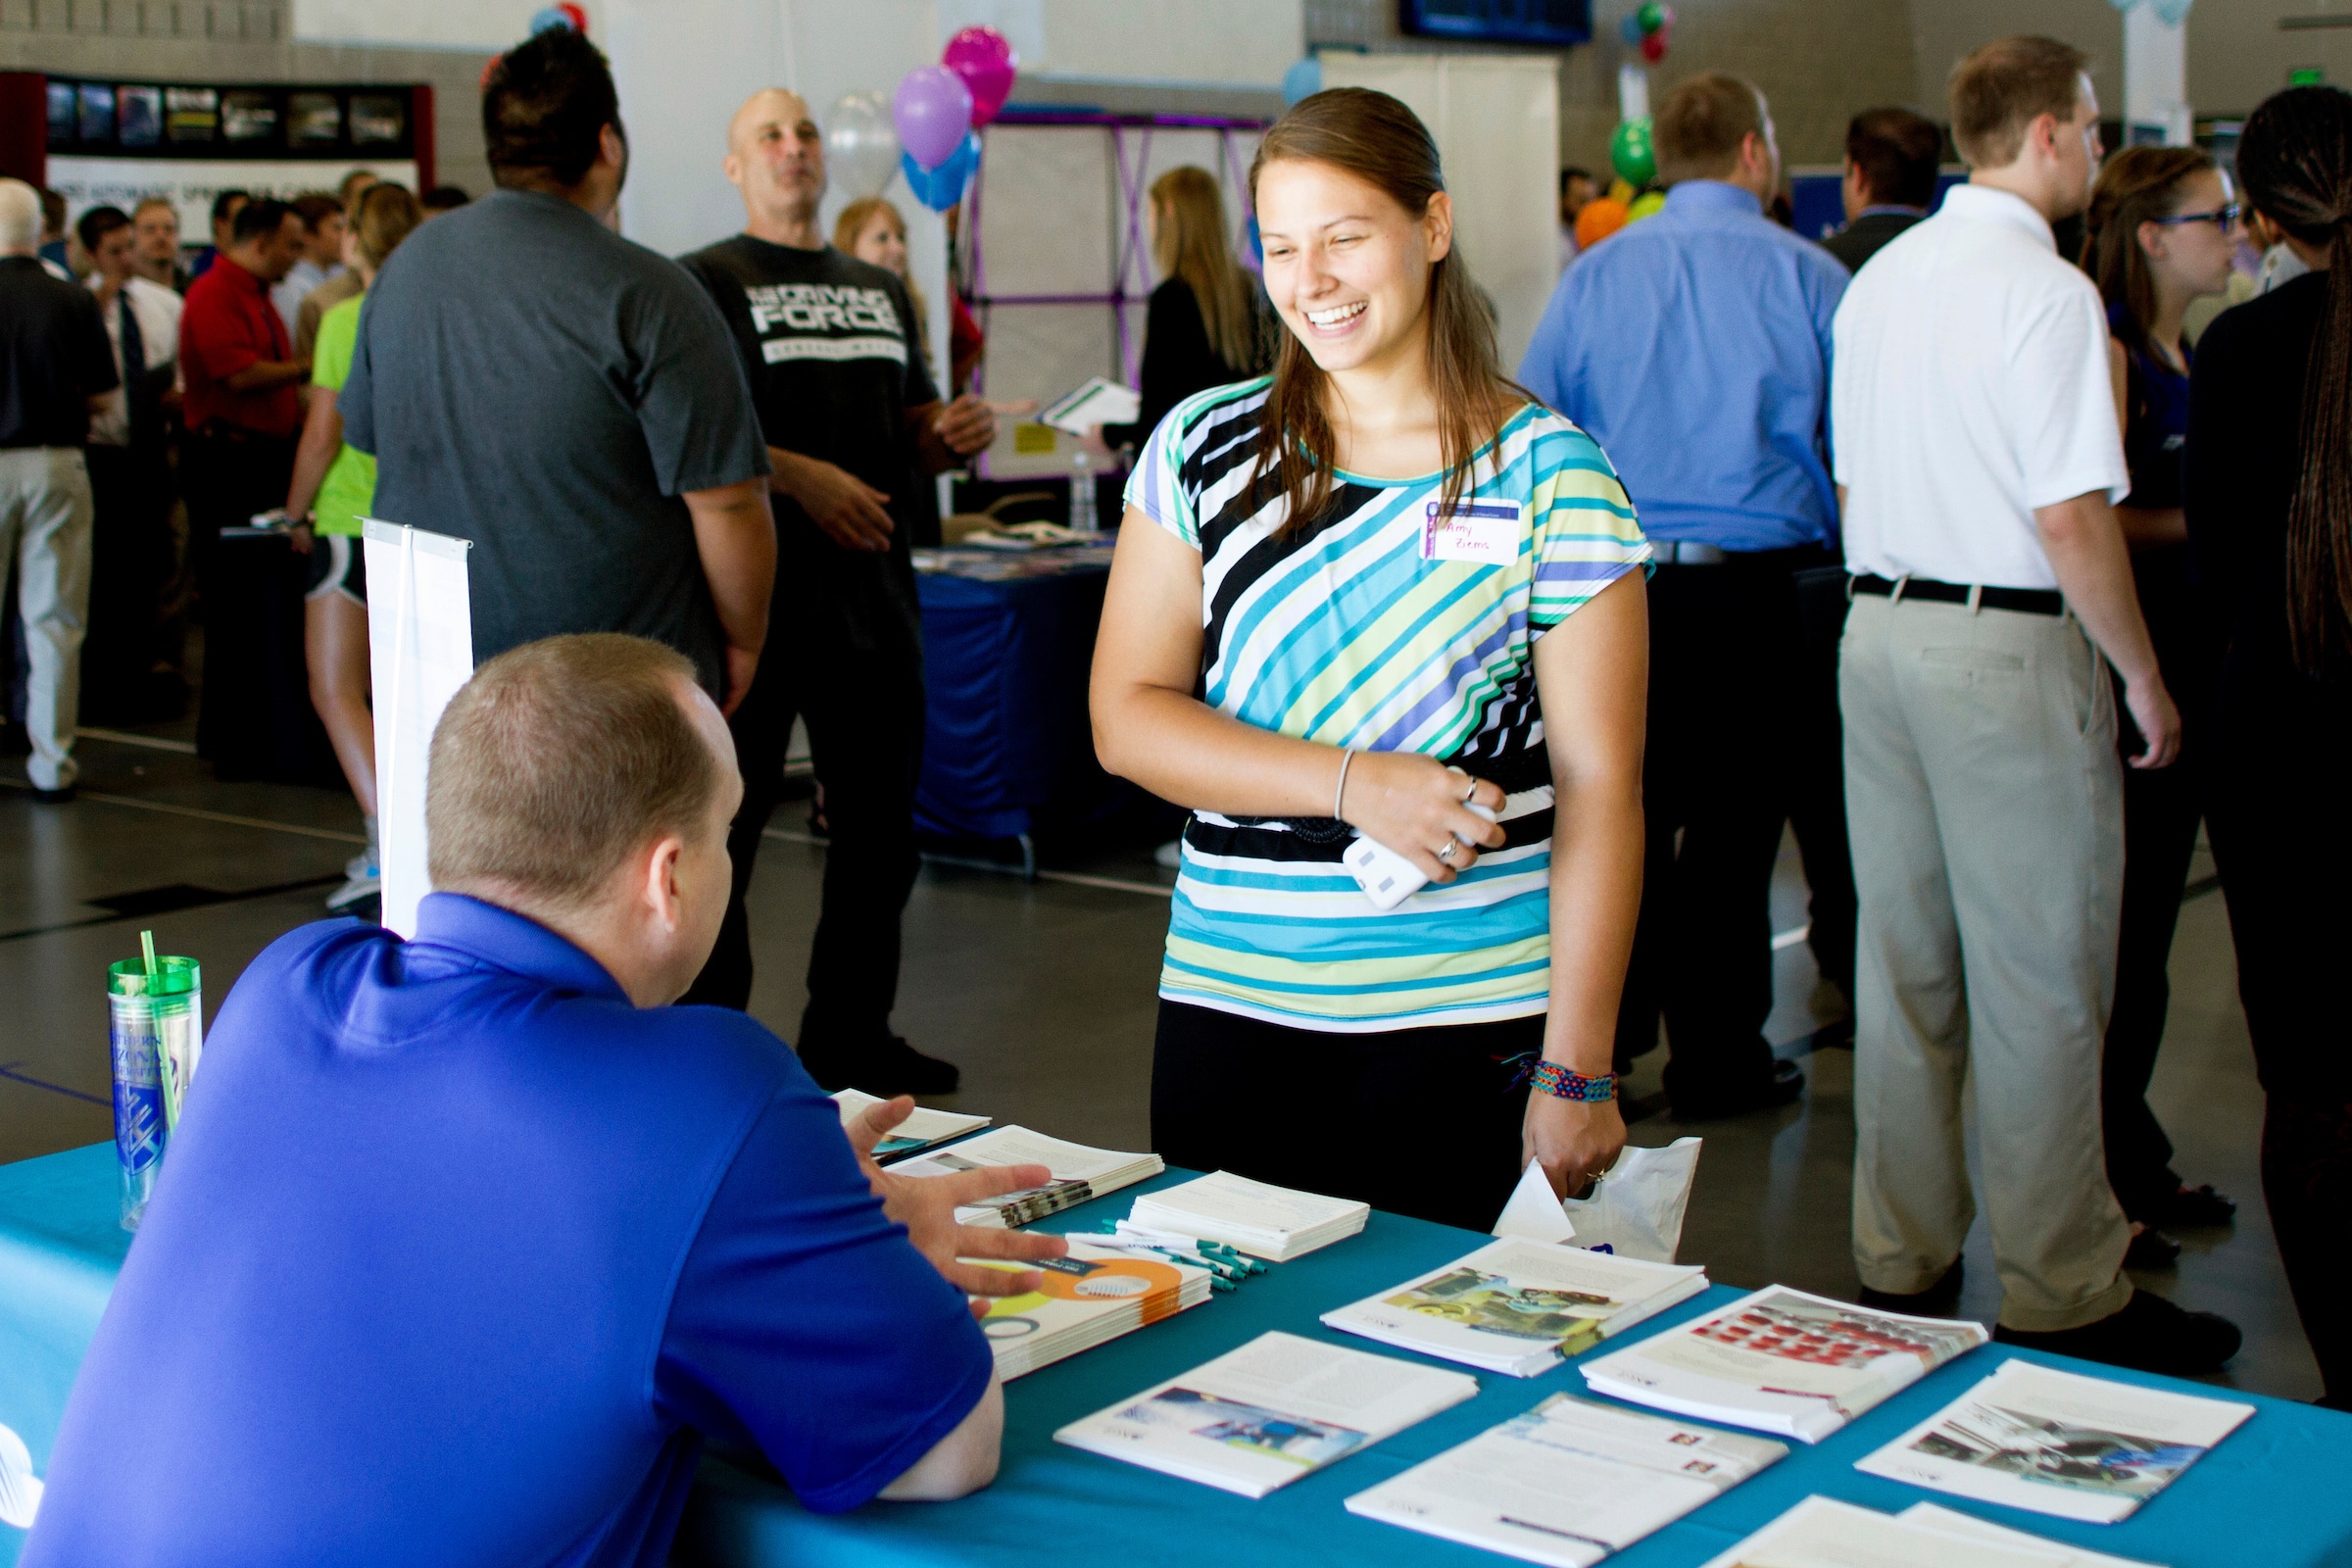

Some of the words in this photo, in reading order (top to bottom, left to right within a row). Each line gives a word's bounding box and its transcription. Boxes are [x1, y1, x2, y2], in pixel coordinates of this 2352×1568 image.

[778, 283, 891, 306] DRIVING
[751, 305, 903, 334] FORCE
[1446, 523, 1472, 536] Amy
